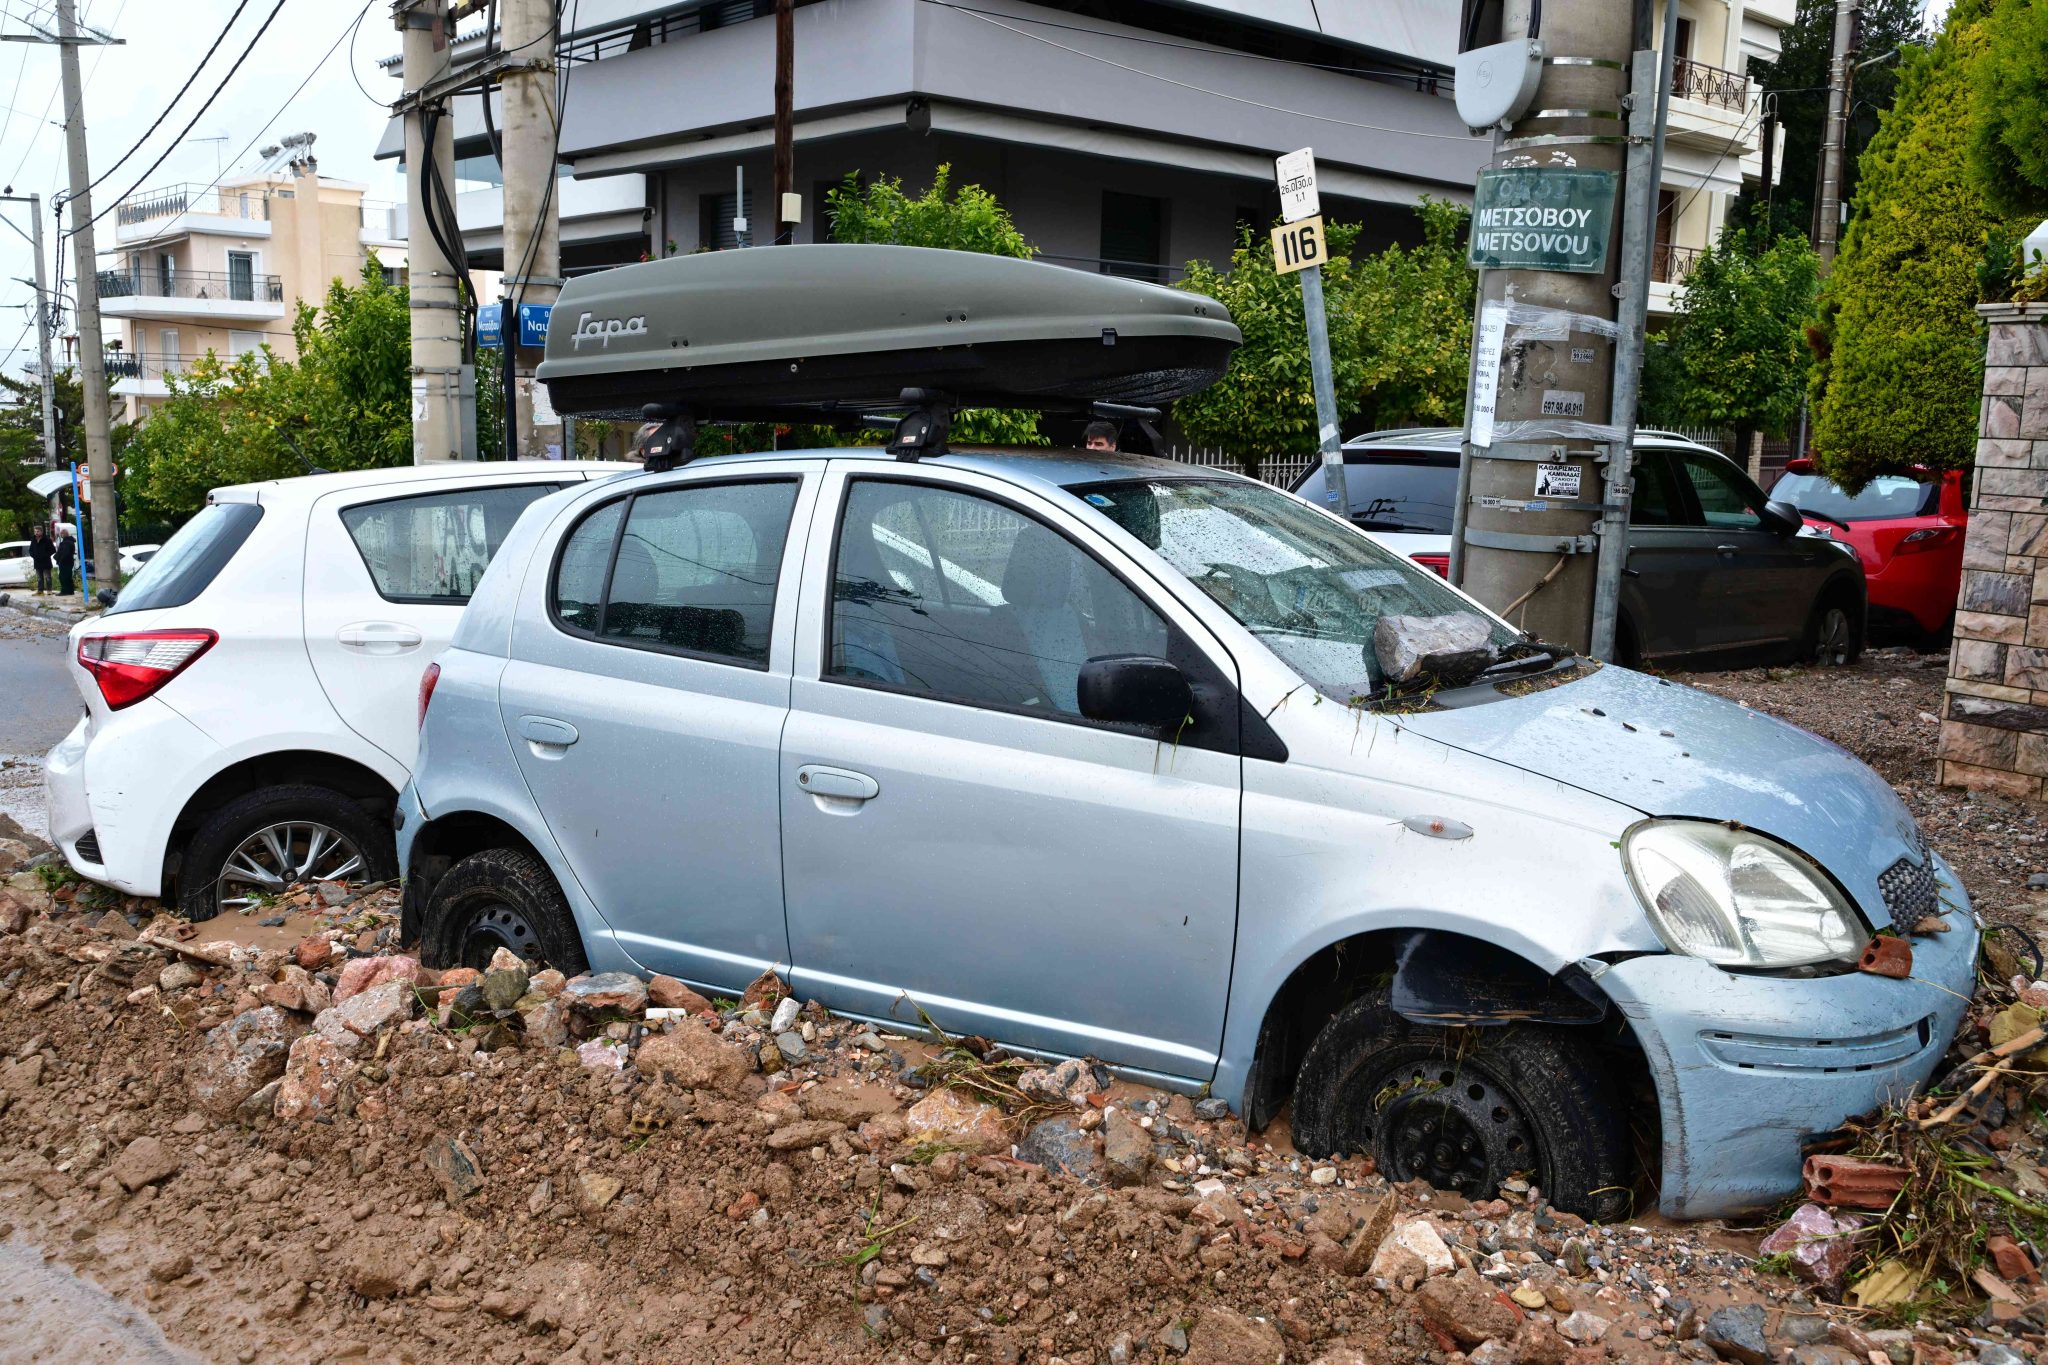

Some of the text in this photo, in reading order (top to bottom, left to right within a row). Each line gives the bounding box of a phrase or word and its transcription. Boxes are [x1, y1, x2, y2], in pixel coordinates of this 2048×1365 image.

[1479, 207, 1592, 228] ΜΕΤΣΟΒΟΥ
[1282, 226, 1317, 266] 116
[1476, 232, 1590, 255] METSOVOU
